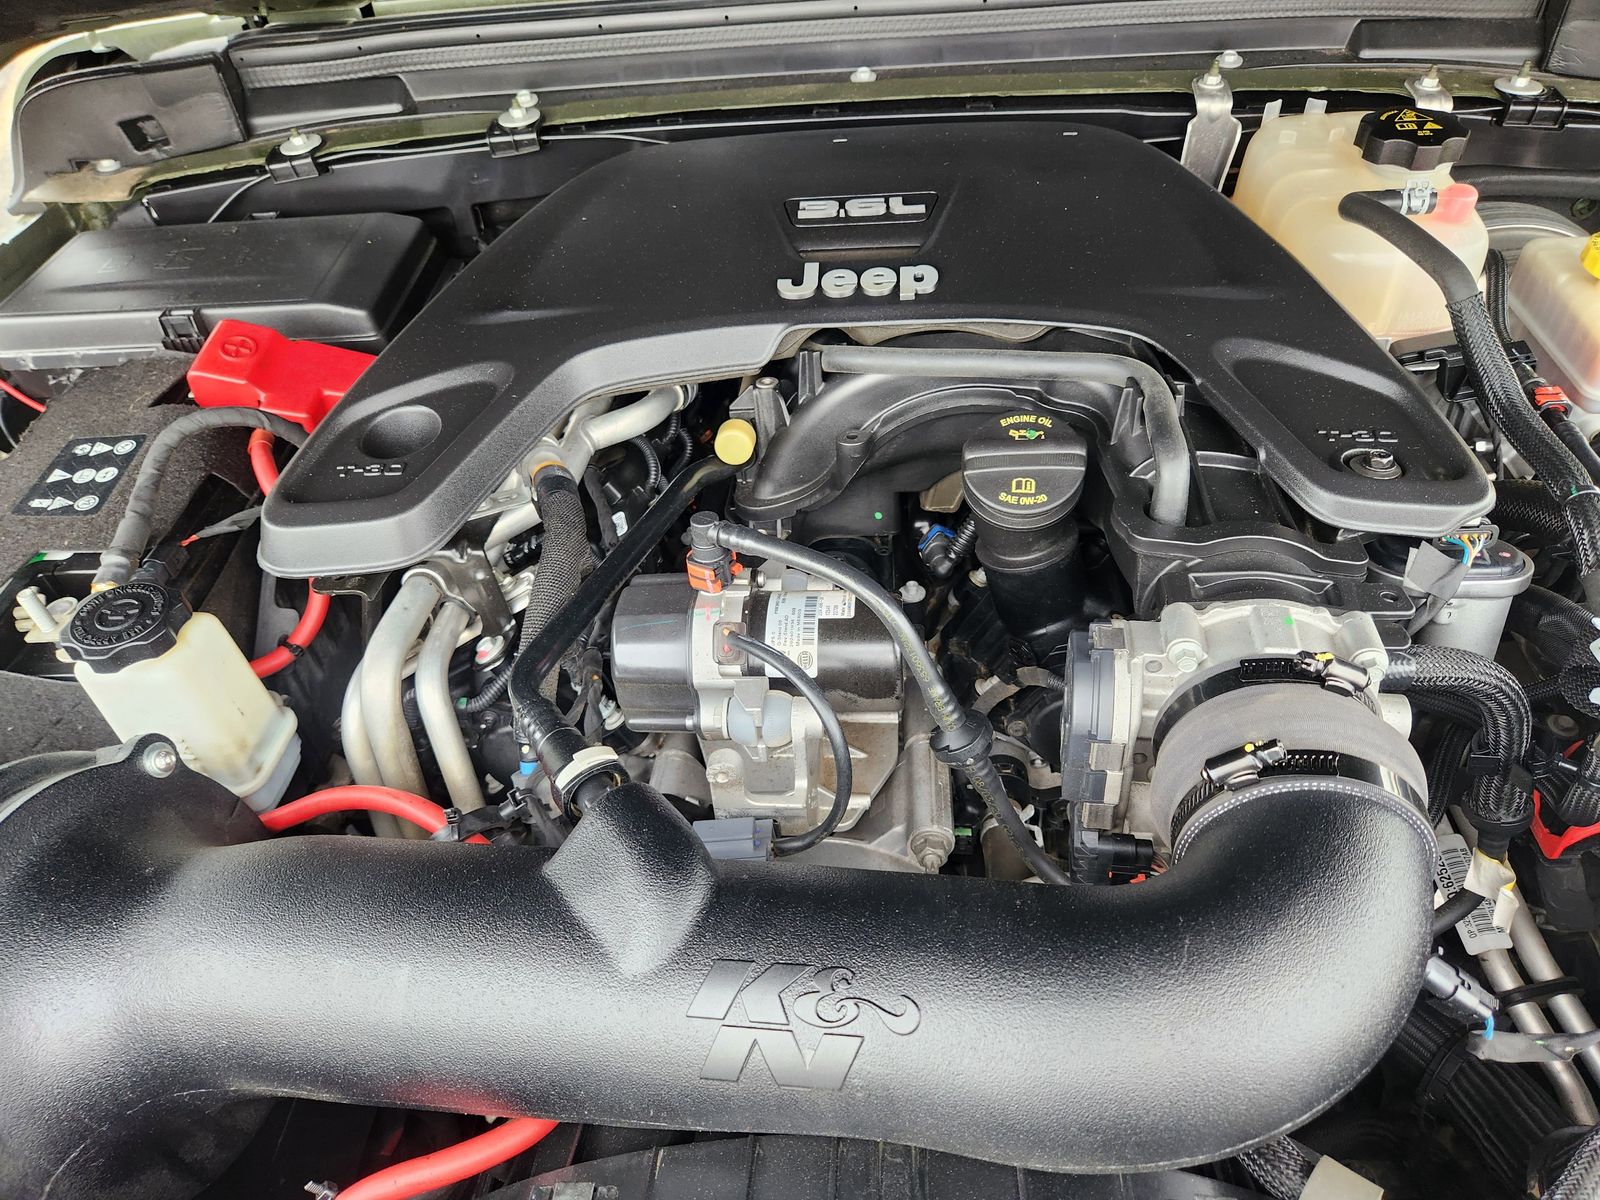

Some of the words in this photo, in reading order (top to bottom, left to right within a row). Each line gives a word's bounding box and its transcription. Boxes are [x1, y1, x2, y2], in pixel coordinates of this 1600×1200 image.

[797, 196, 926, 219] 3.6L
[776, 262, 939, 300] Jeep
[1000, 415, 1037, 427] ENGINE
[1037, 416, 1053, 428] OIL
[999, 492, 1019, 505] SAE
[1019, 494, 1048, 506] 0W-20
